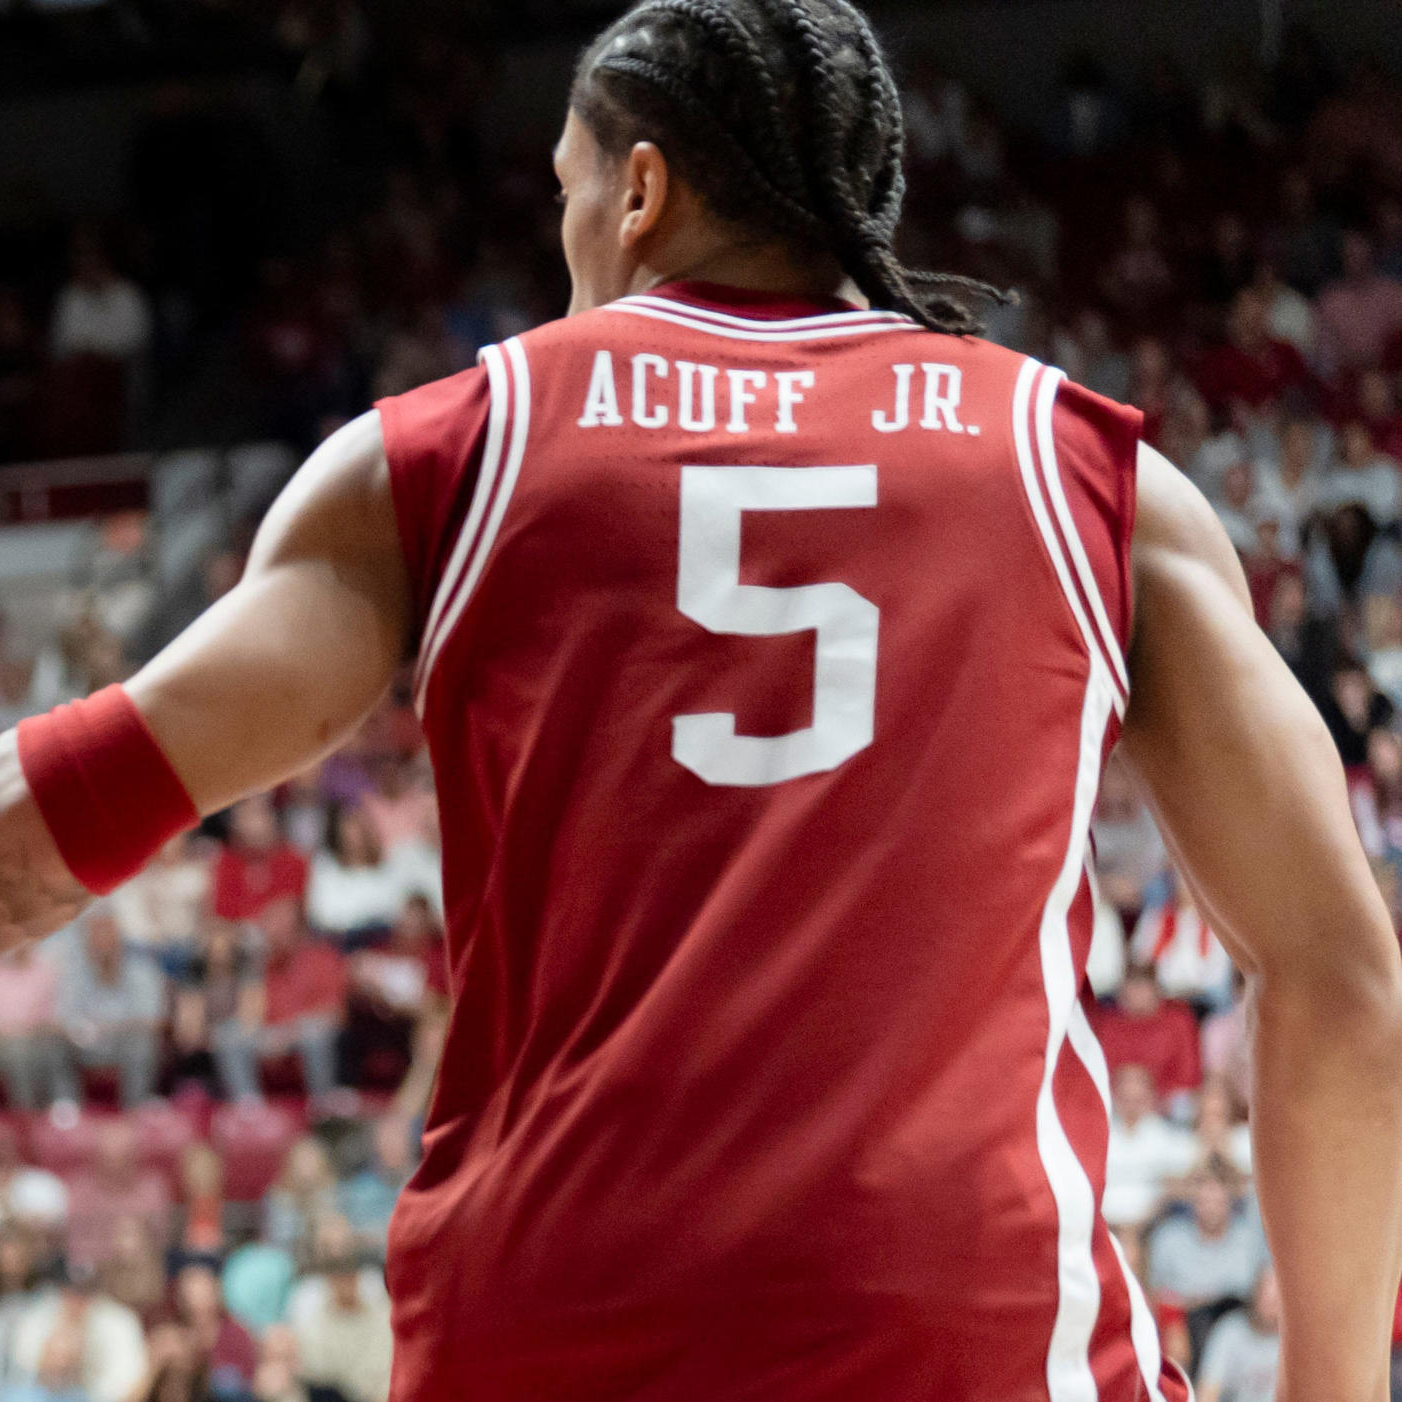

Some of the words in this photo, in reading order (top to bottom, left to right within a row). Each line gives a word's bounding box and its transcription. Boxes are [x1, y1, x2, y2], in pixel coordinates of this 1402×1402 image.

[577, 350, 815, 434] ACUFF
[871, 362, 981, 436] JR.
[671, 463, 880, 788] 5
